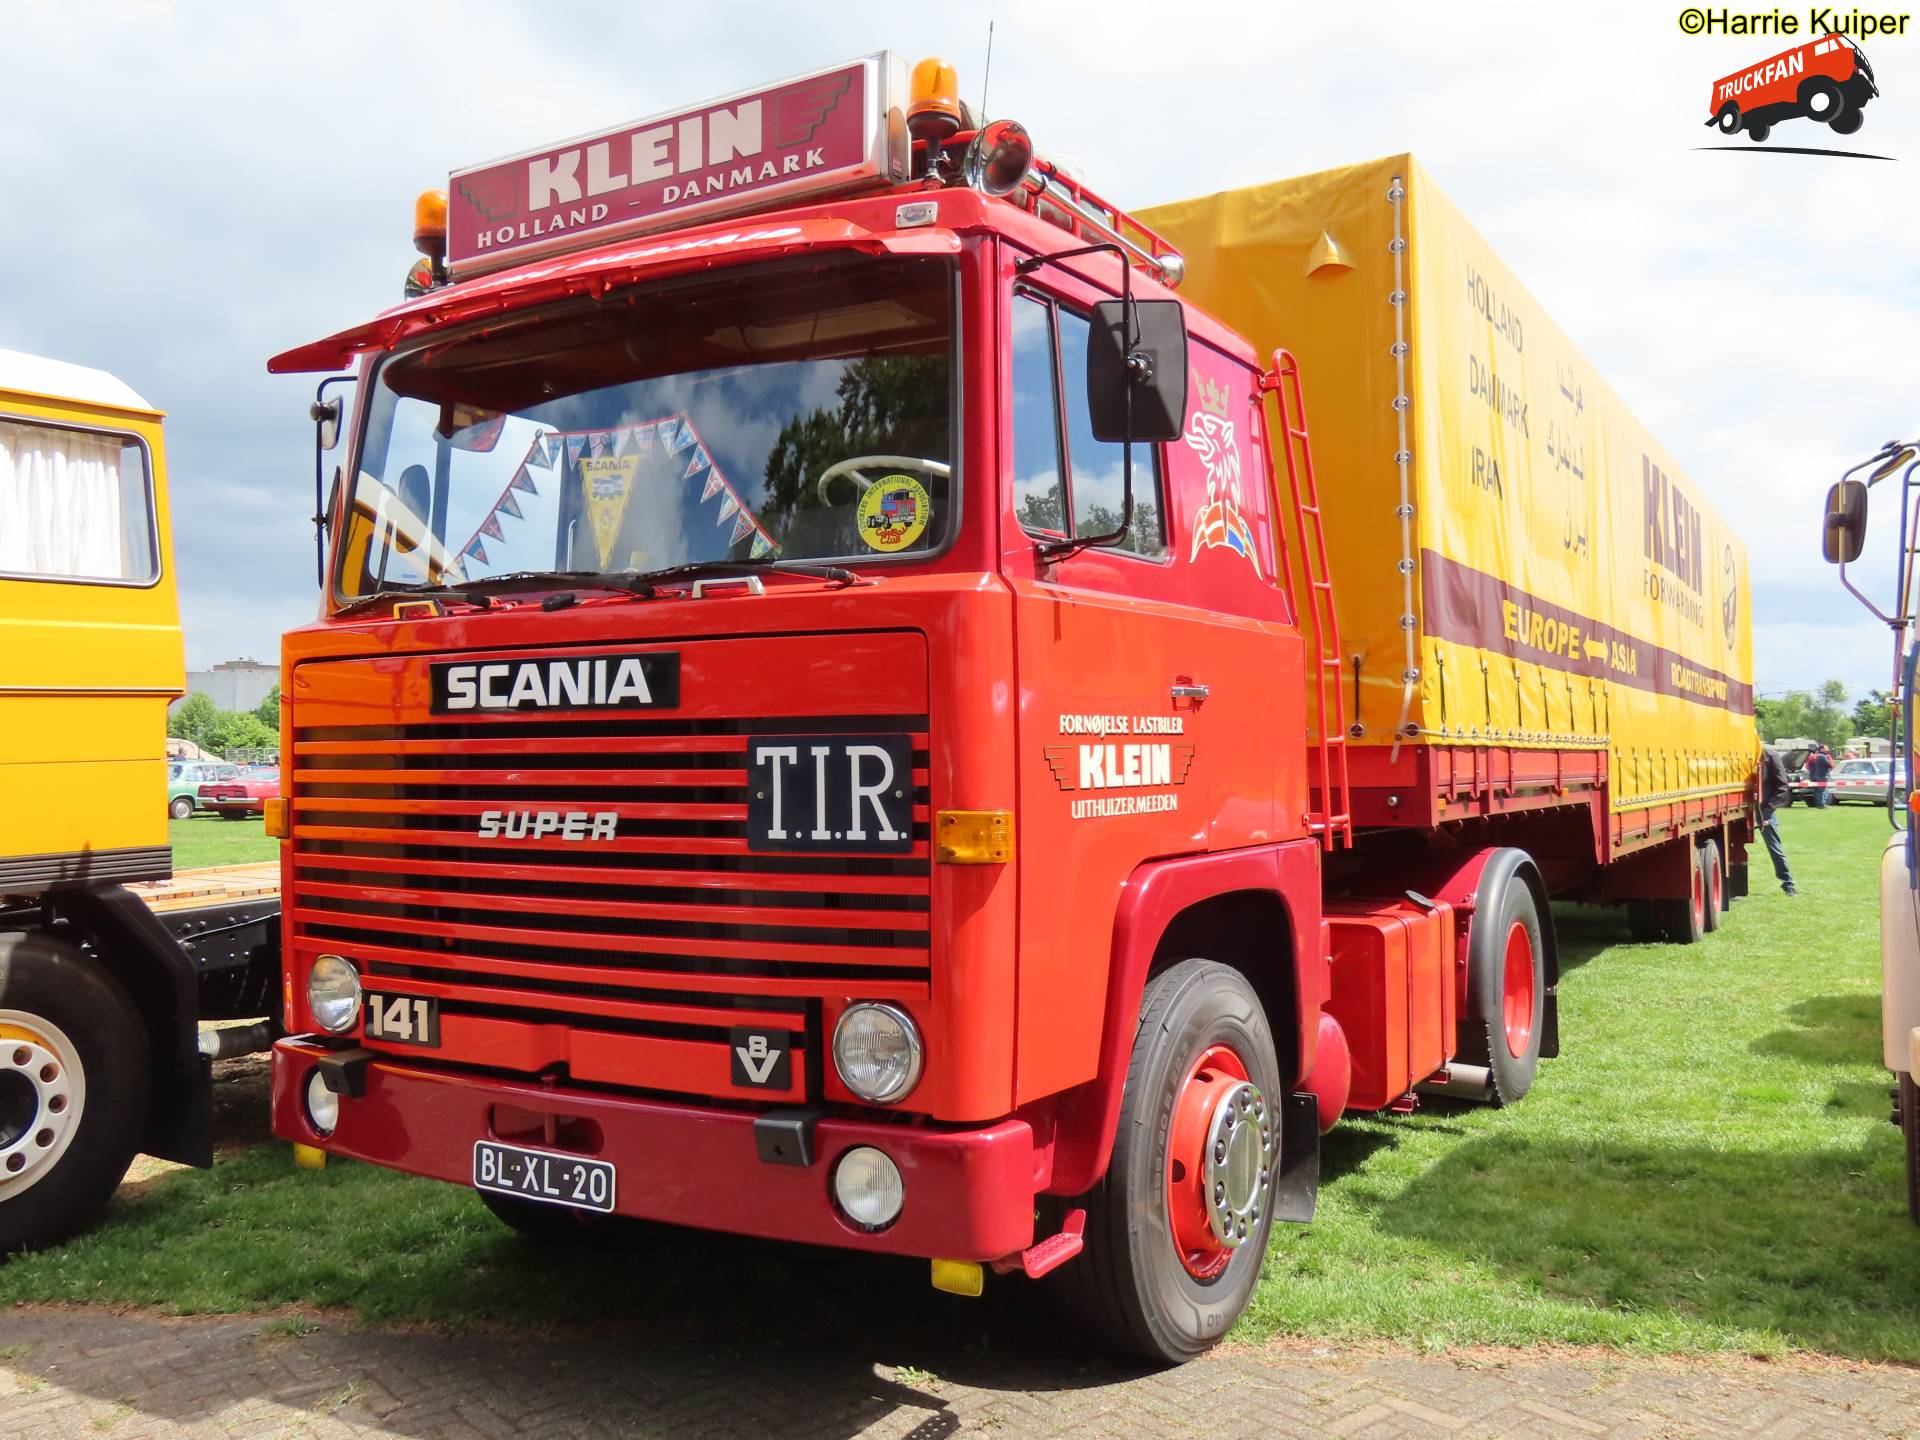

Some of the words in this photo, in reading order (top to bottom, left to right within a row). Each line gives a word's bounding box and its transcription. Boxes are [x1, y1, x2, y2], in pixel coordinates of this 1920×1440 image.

[528, 99, 762, 212] KLEIN
[477, 203, 609, 249] HOLLAND
[661, 147, 825, 205] DANMARK
[1466, 263, 1523, 353] HOLLAND
[1469, 353, 1529, 439] DANMARK
[1471, 446, 1503, 501] IRAN
[1642, 453, 1703, 597] KLEIN
[1643, 569, 1704, 630] FORWARDING
[1502, 599, 1581, 661] EUROPE
[1610, 640, 1638, 678] ASIA
[446, 658, 654, 710] SCANIA
[1132, 715, 1184, 736] LASTBILER
[755, 744, 909, 842] T.I.R.
[1079, 743, 1172, 791] KLEIN
[478, 810, 620, 842] SUPER
[1071, 793, 1178, 820] UITHUIZERMEEDEN
[369, 994, 430, 1043] 141
[480, 1147, 608, 1204] BL-XL-20
